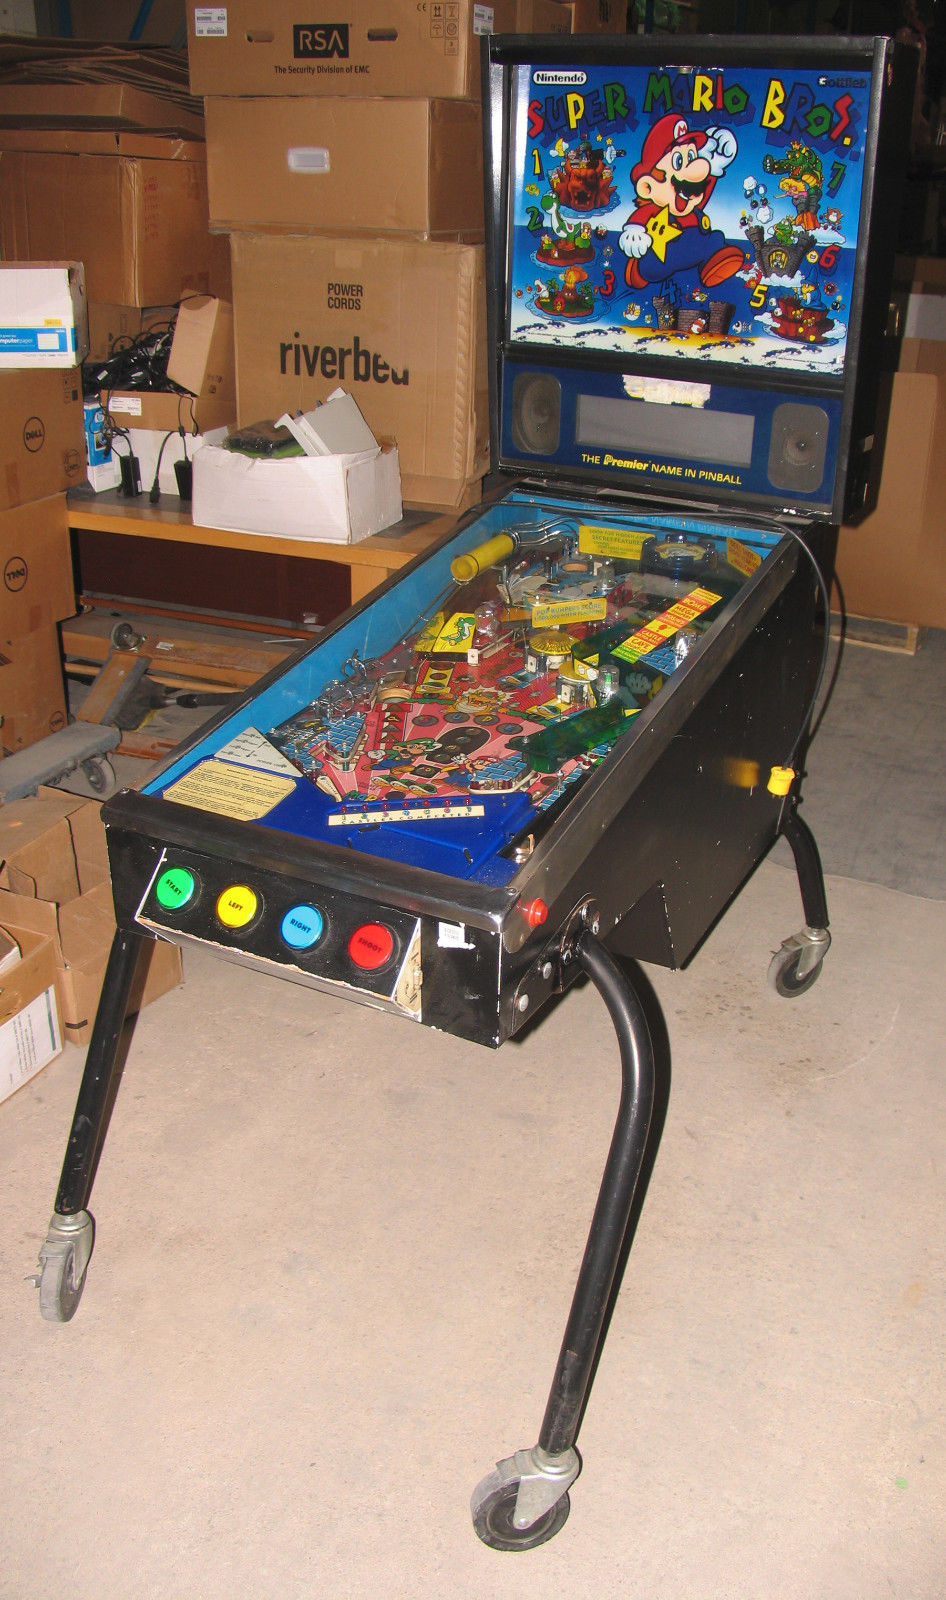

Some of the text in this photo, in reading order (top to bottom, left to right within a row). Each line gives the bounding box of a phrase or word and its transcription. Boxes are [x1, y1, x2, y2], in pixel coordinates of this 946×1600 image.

[299, 29, 344, 51] RSA
[274, 65, 370, 76] The Security Division of EMC
[536, 72, 584, 82] Nintendo
[527, 82, 630, 139] SUPER
[643, 71, 750, 116] MARIO
[531, 147, 542, 175] 1
[827, 160, 848, 190] 7
[526, 205, 543, 232] 2
[819, 243, 841, 269] 6
[327, 283, 363, 297] POWER
[600, 269, 615, 296] 3
[327, 297, 361, 311] CORDS
[749, 284, 769, 309] 5
[26, 430, 42, 440] DELL
[581, 453, 742, 485] THE Premier NAME IN PINBALL
[166, 879, 181, 896] START
[228, 900, 243, 911] LEFT
[289, 918, 312, 934] RIGHT
[357, 936, 383, 954] SHOOT
